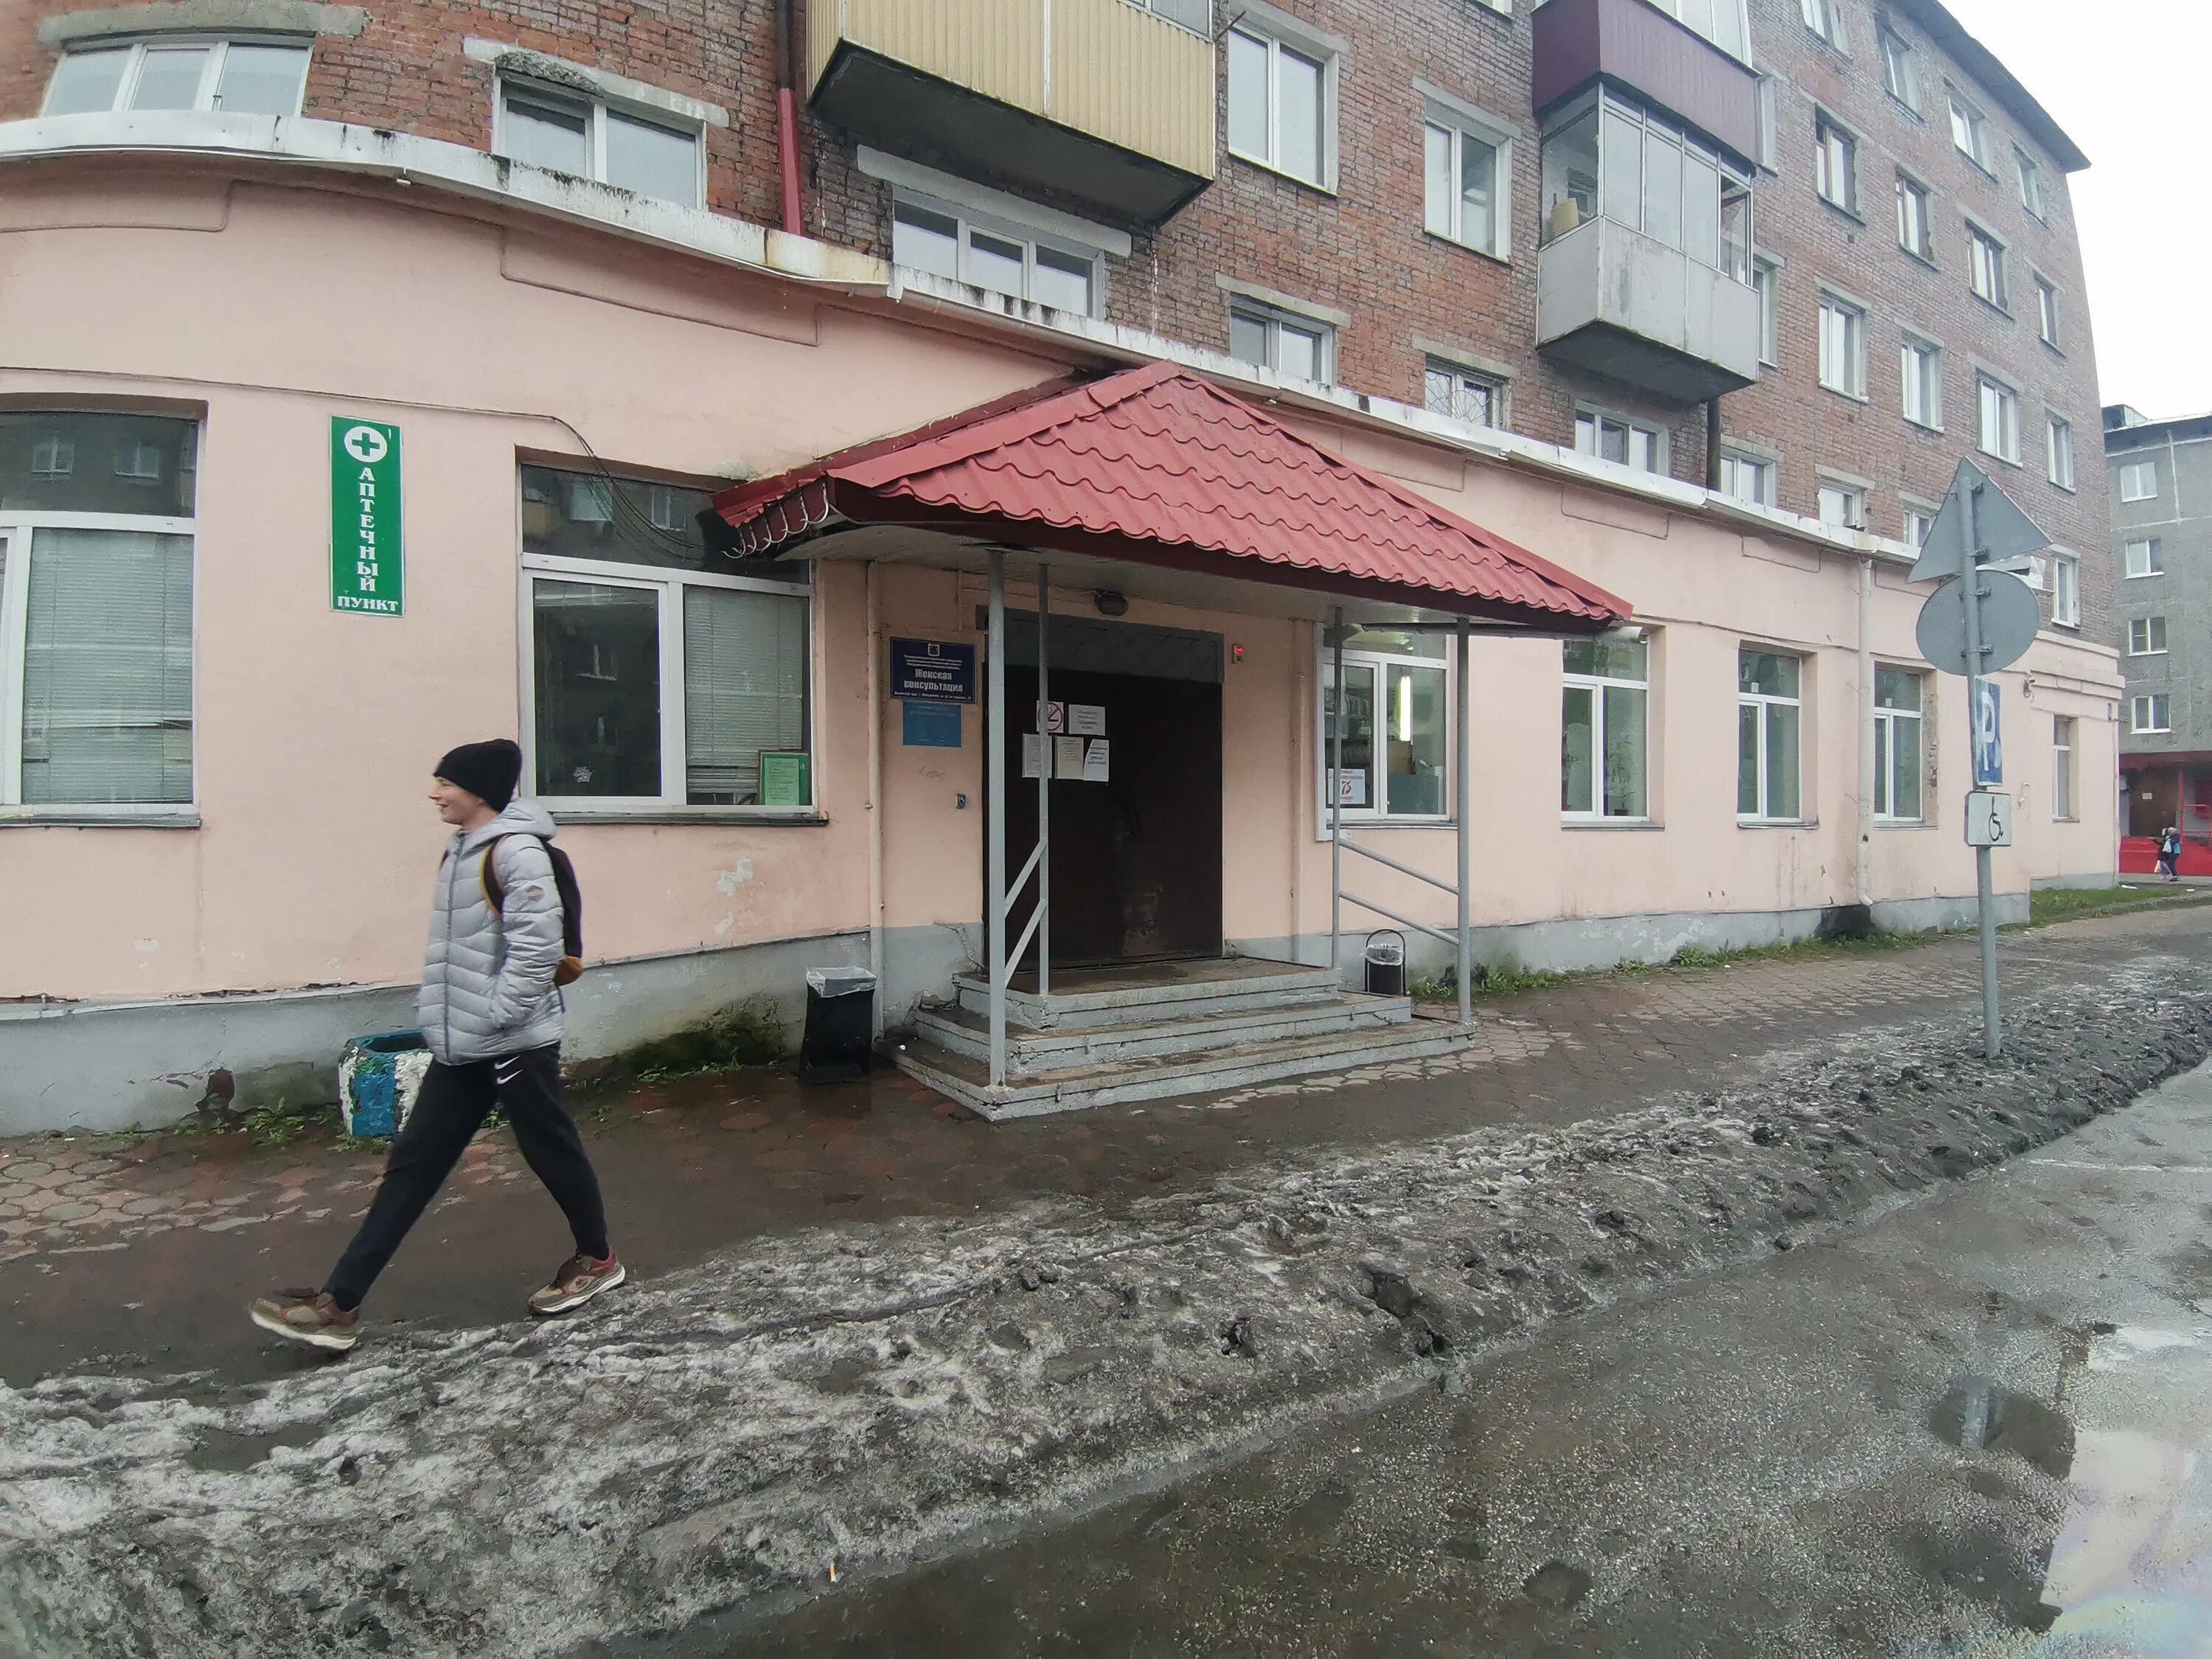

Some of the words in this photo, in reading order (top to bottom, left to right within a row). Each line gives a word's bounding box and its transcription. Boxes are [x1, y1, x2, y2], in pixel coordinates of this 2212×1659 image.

[357, 467, 379, 592] АПТЕЧНЫЙ
[337, 596, 398, 612] ПУНКТ
[904, 681, 963, 692] консультация
[1981, 691, 1995, 771] P
